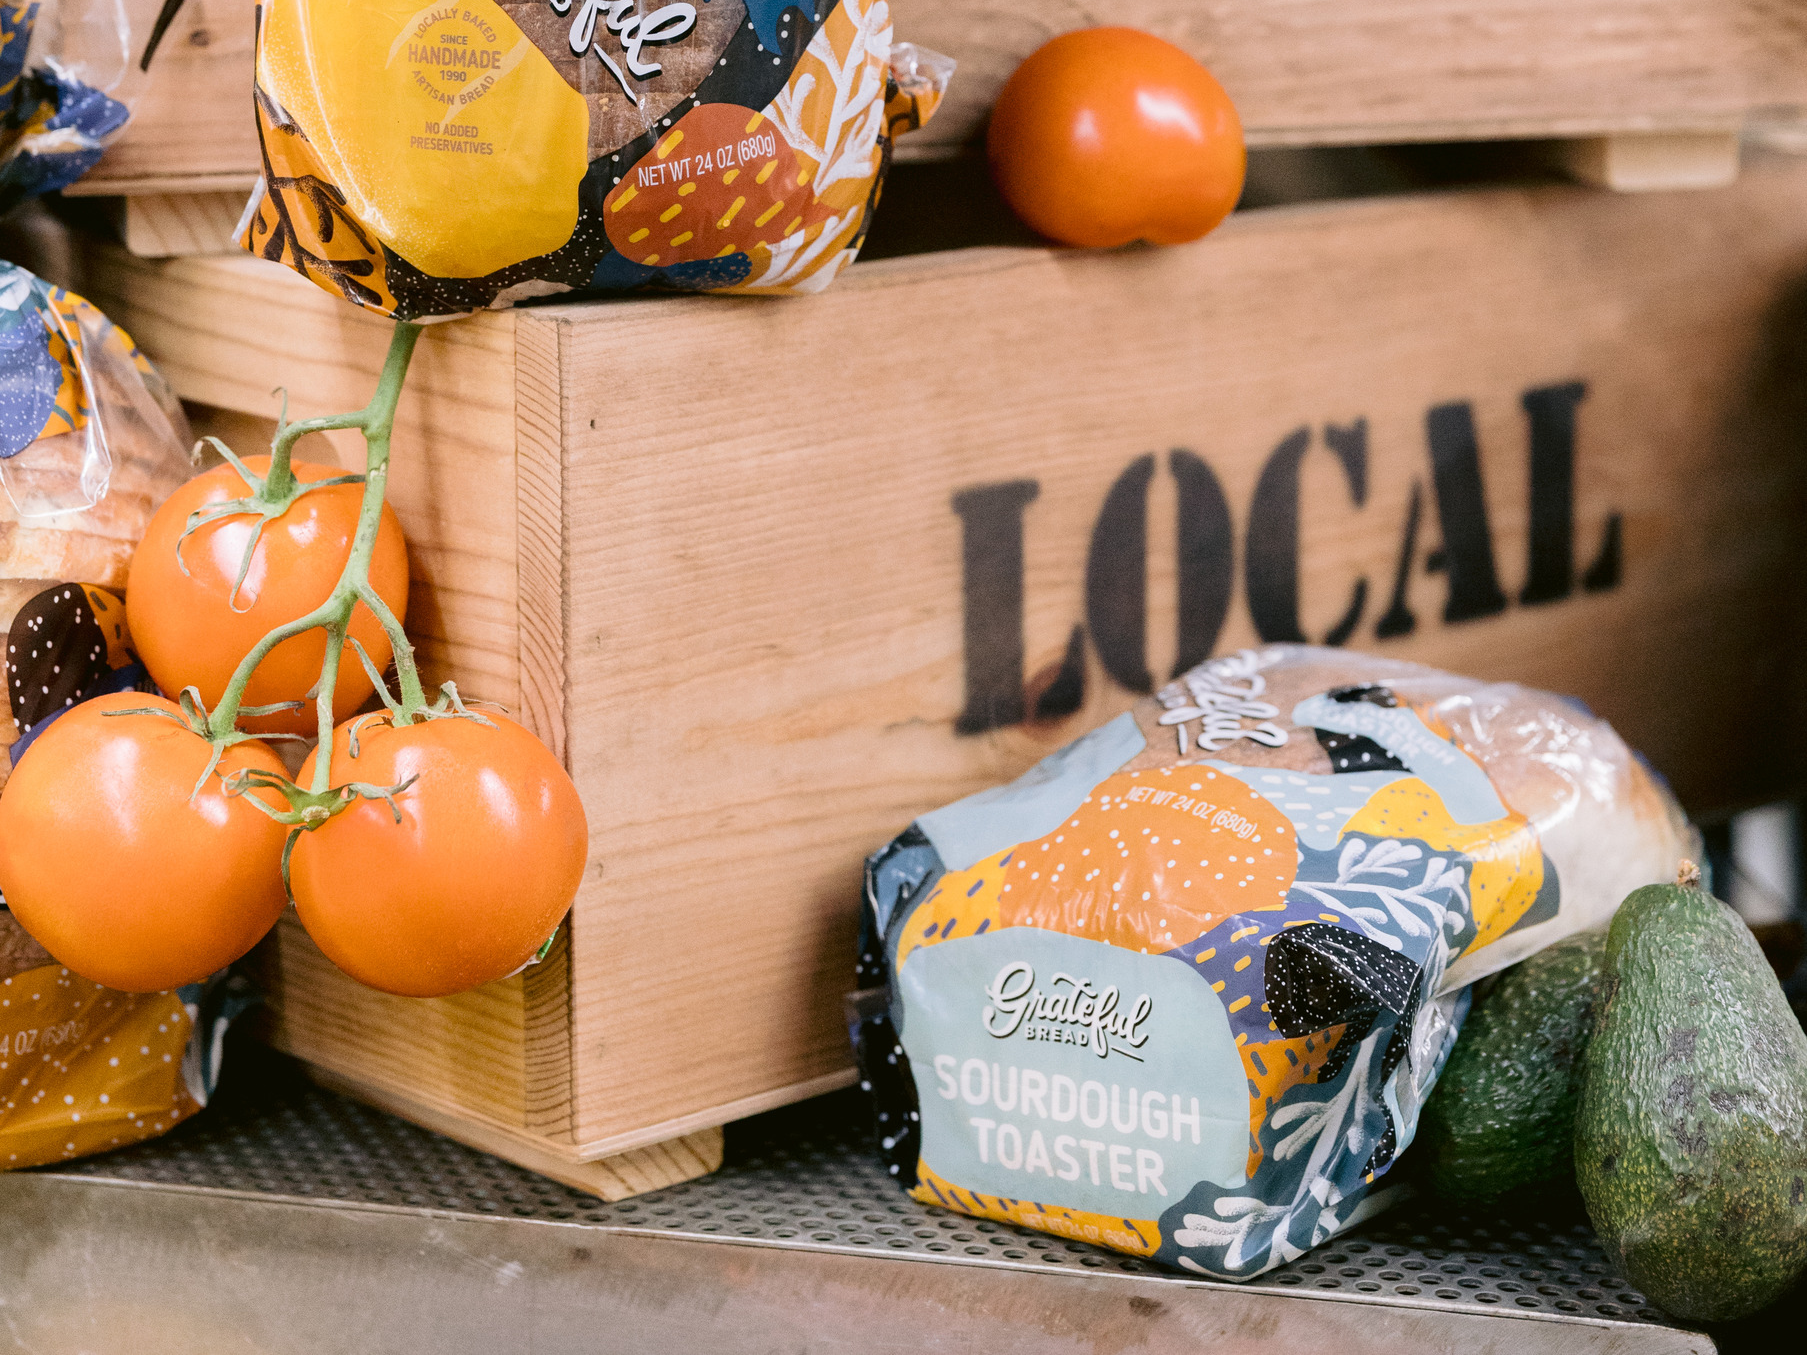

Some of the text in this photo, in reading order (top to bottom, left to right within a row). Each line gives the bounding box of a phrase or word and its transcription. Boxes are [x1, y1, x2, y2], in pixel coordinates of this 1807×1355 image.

[414, 8, 497, 43] LOCALLY BAKED
[440, 34, 469, 46] SINCE
[408, 43, 502, 70] HANDMADE
[412, 69, 496, 106] ARTISAN BREAD
[439, 69, 467, 83] 1990
[410, 135, 494, 156] PRESERVATIVES
[425, 121, 479, 139] NO ADDED
[638, 130, 776, 188] NET WT 24 OZ (680g)
[950, 380, 1624, 737] LOCAL
[1125, 786, 1258, 839] NET WT 24 OZ (680g)
[982, 960, 1153, 1059] Grateful
[1025, 1025, 1089, 1046] BREAD
[934, 1053, 1200, 1145] SOURDOUGH
[969, 1116, 1168, 1197] TOASTER
